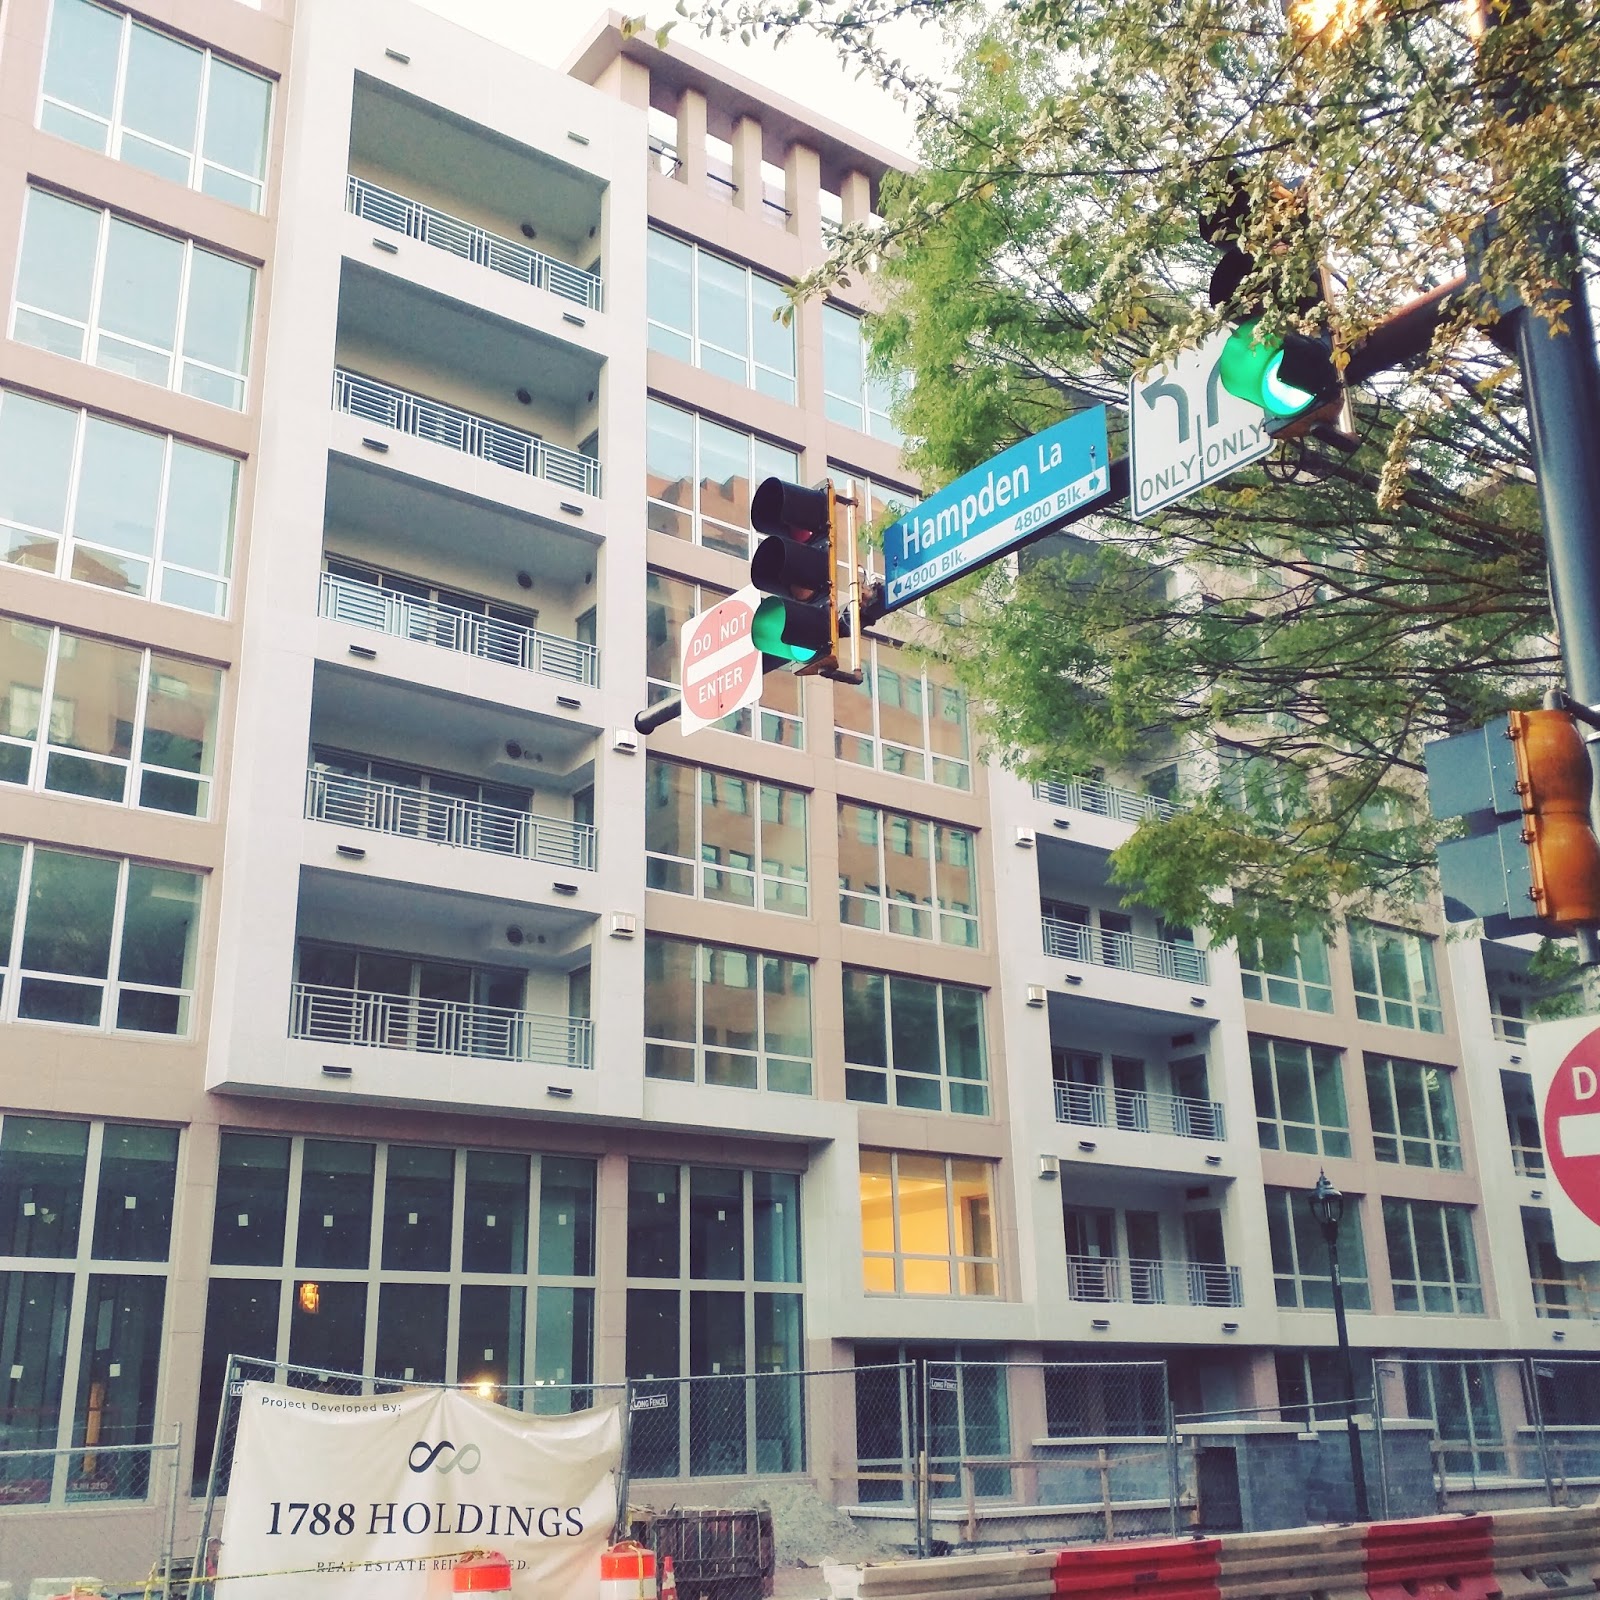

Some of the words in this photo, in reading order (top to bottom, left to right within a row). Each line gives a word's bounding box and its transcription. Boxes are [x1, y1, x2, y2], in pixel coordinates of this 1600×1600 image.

[1140, 454, 1196, 501] ONLY
[1206, 417, 1265, 467] ONLY
[902, 464, 1030, 560] Hampden
[1038, 442, 1063, 474] La
[1014, 501, 1052, 532] 4800
[1057, 486, 1087, 511] Blk.
[904, 563, 937, 590] 4900
[941, 549, 967, 574] Blk.
[693, 633, 712, 657] DO
[720, 611, 748, 642] NOT
[698, 666, 743, 704] ENTER
[261, 1396, 307, 1410] Project
[311, 1402, 377, 1413] Developed
[382, 1403, 402, 1413] By:
[634, 1399, 649, 1408] LONG
[265, 1502, 356, 1536] 1788
[366, 1502, 585, 1537] HOLDINGS
[316, 1561, 356, 1573] REAL
[364, 1559, 426, 1572] ESTATE
